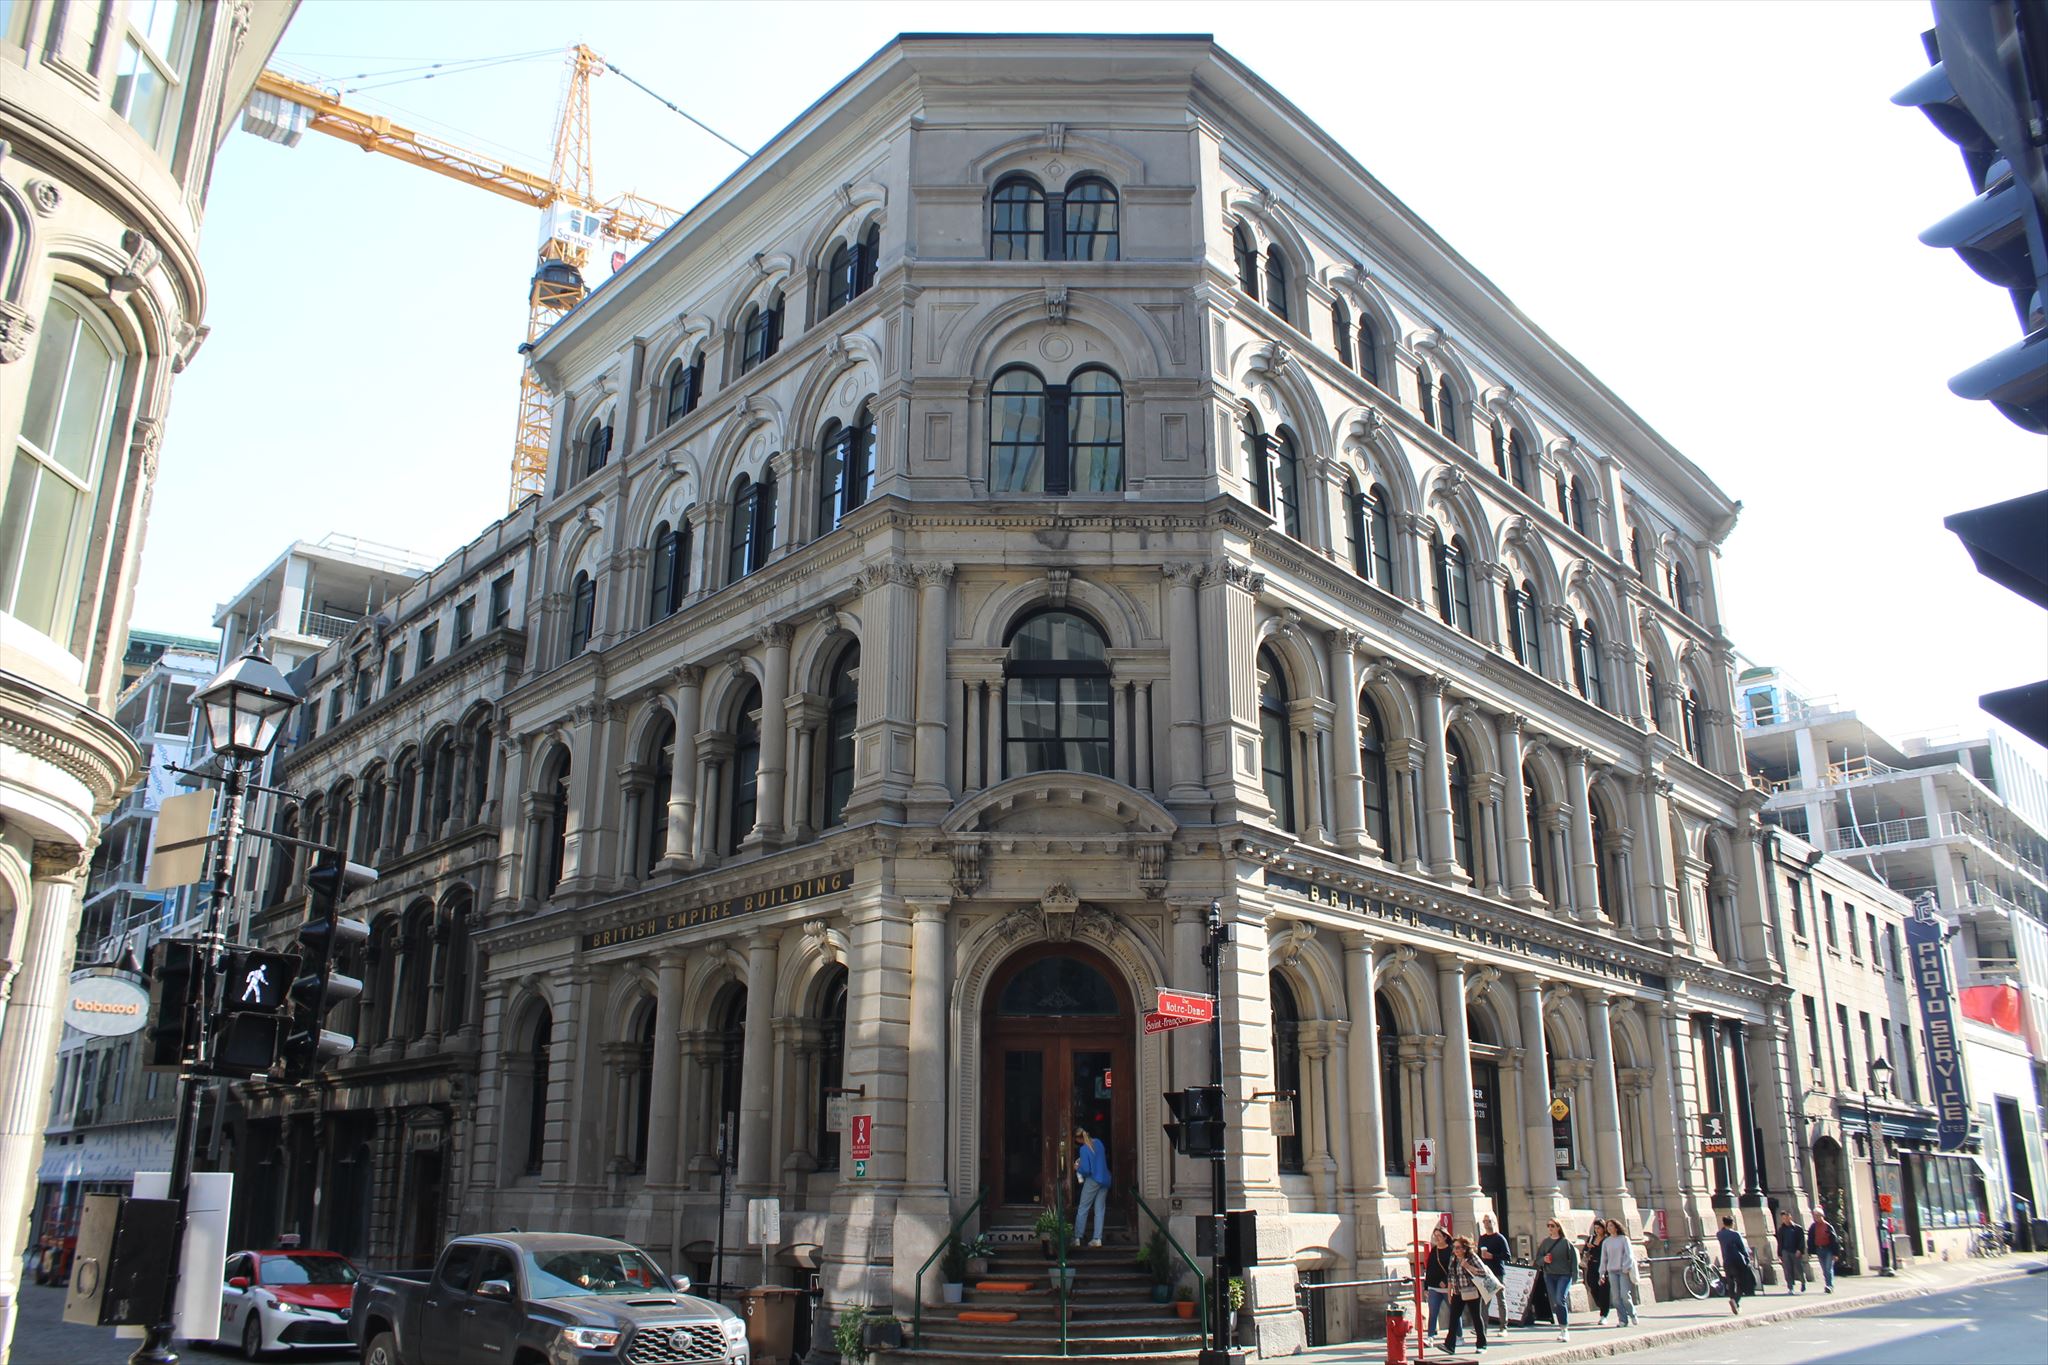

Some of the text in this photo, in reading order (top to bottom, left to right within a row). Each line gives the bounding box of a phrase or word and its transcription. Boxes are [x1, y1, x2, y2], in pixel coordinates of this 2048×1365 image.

[594, 874, 842, 947] BRITISH EMPIRE BUILDING
[1311, 885, 1642, 985] BRITISH EMPIRE BUILDING
[74, 997, 139, 1015] babacool
[1166, 1001, 1206, 1016] Notre-Dame
[1917, 942, 1962, 1120] PHOTO SERVICE
[1704, 1138, 1727, 1146] SUSHI
